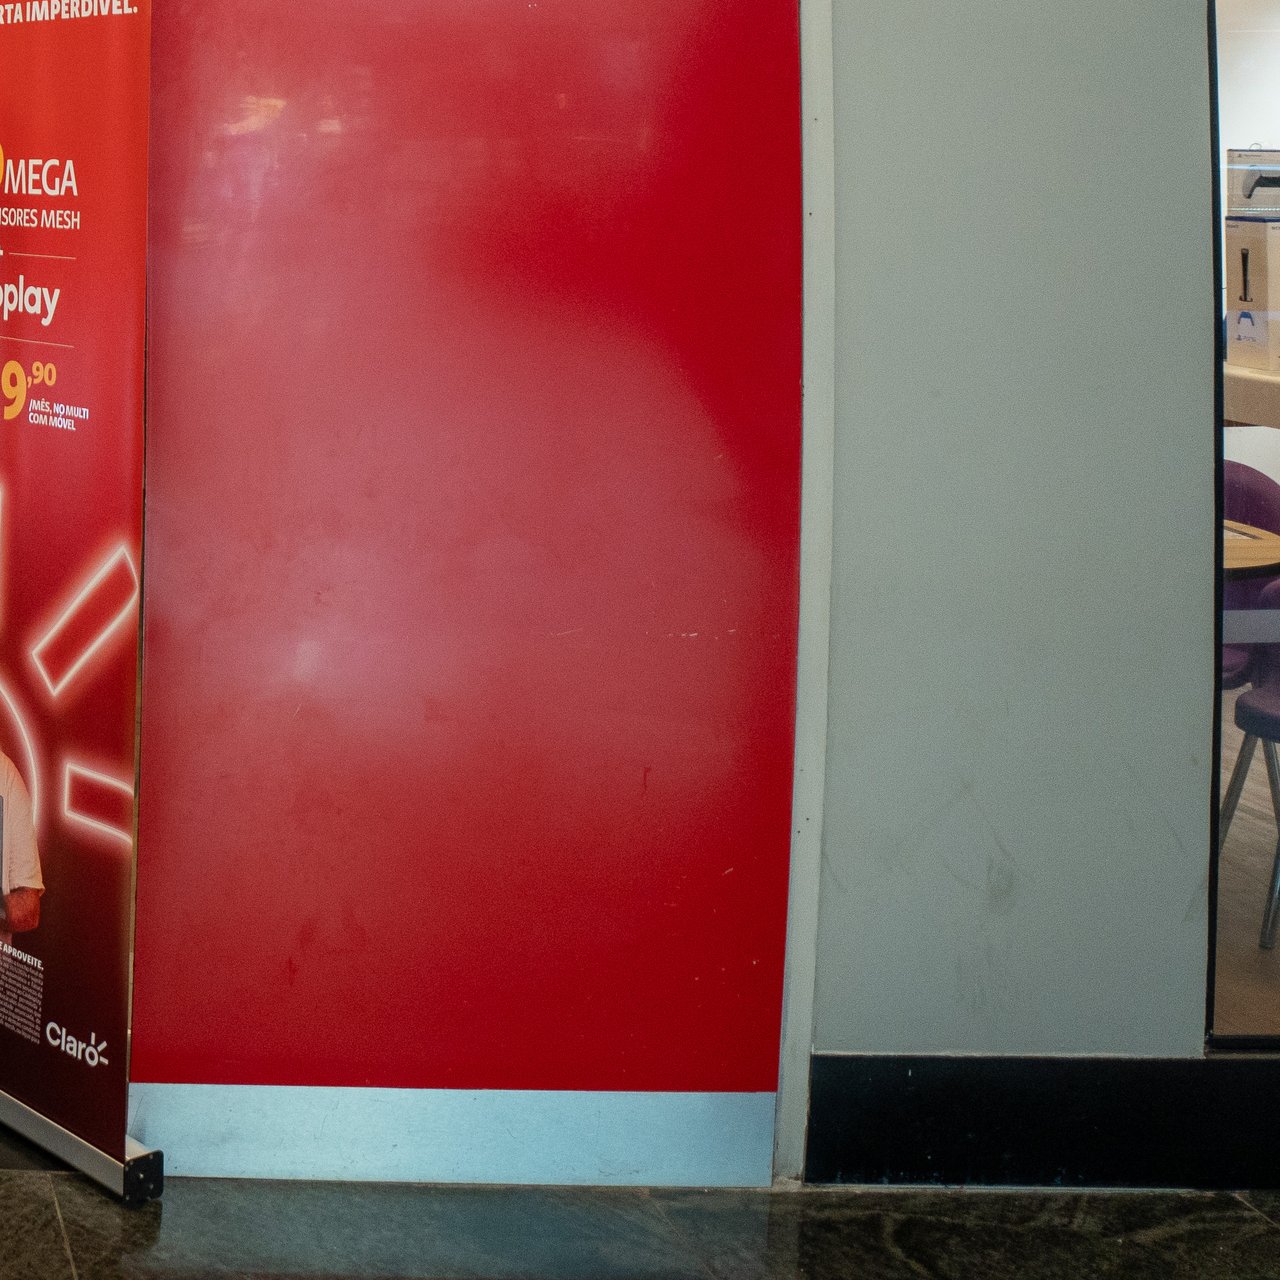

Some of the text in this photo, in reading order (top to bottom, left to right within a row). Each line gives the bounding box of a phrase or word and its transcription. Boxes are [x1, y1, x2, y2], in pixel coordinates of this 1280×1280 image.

[40, 210, 81, 230] MESH
[28, 412, 76, 431] COM MÓVEL
[53, 403, 65, 415] NO
[65, 405, 89, 420] MULTI
[3, 943, 44, 971] APROVEITE.
[46, 1021, 99, 1067] Claro
